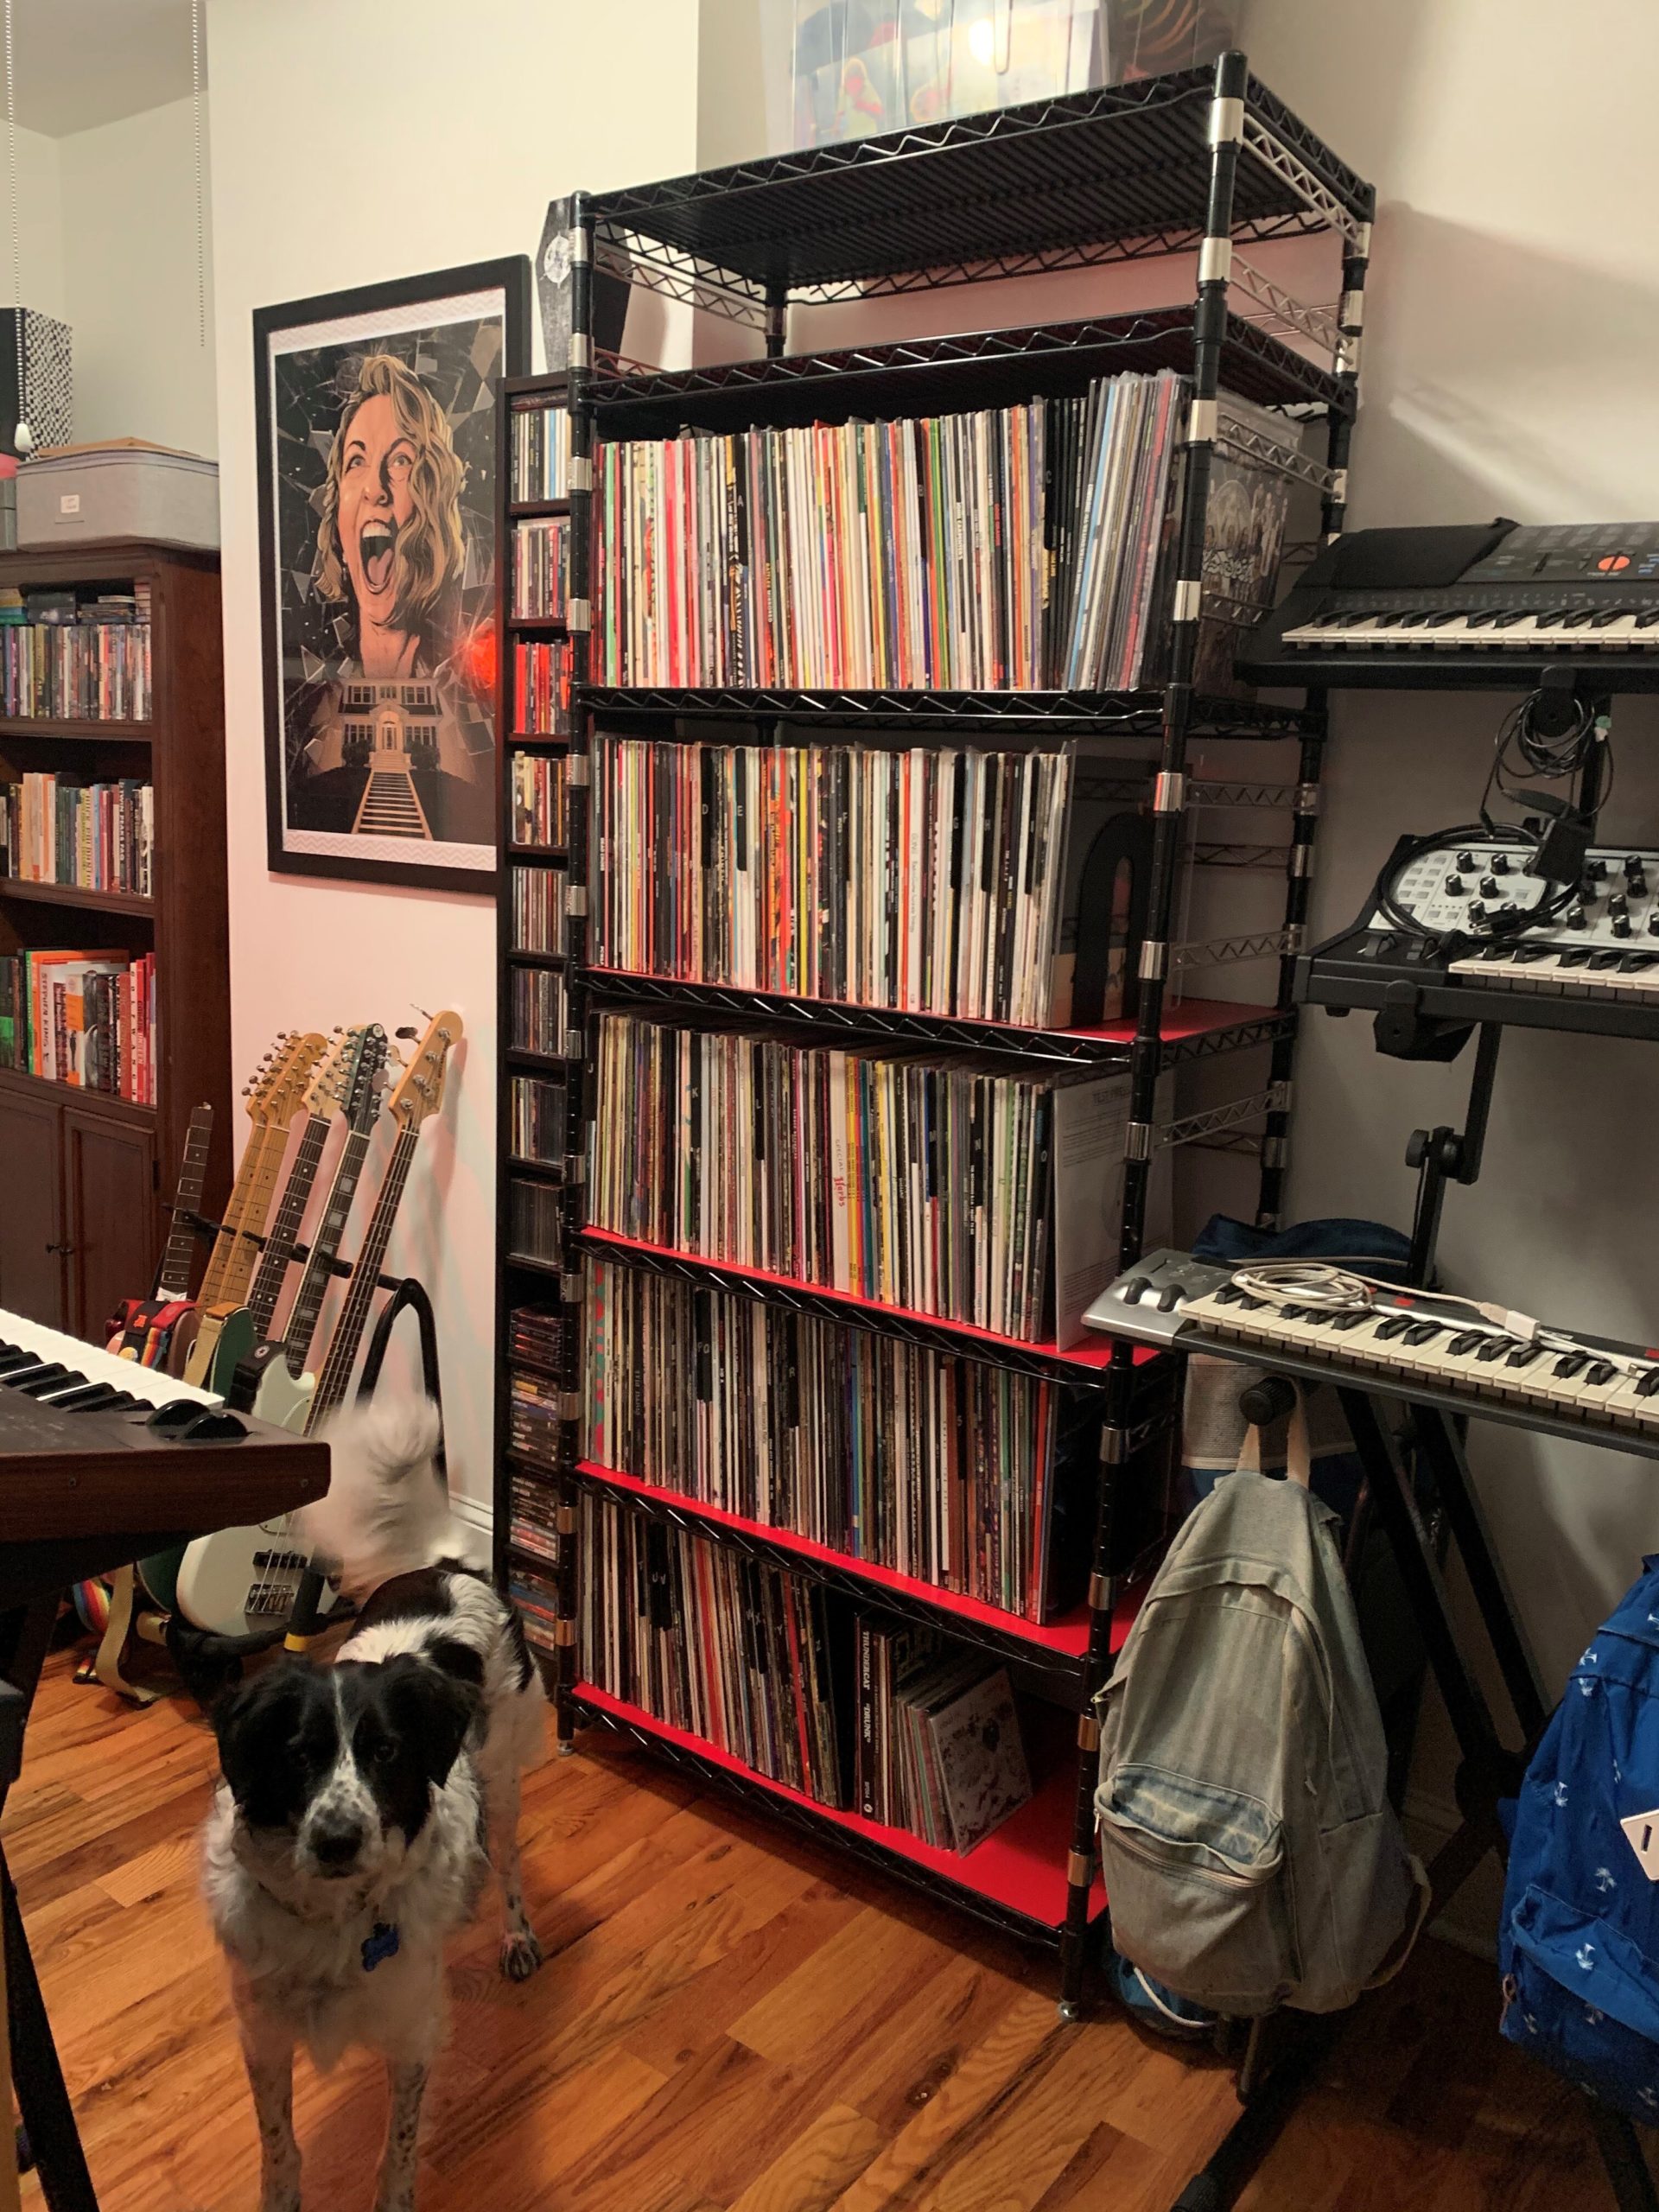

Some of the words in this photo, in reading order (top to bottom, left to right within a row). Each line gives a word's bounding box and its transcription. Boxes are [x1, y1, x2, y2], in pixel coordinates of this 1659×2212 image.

[836, 1139, 844, 1172] SPECIAL
[833, 1177, 847, 1207] Herbs
[861, 1630, 870, 1690] THUNDERCAT
